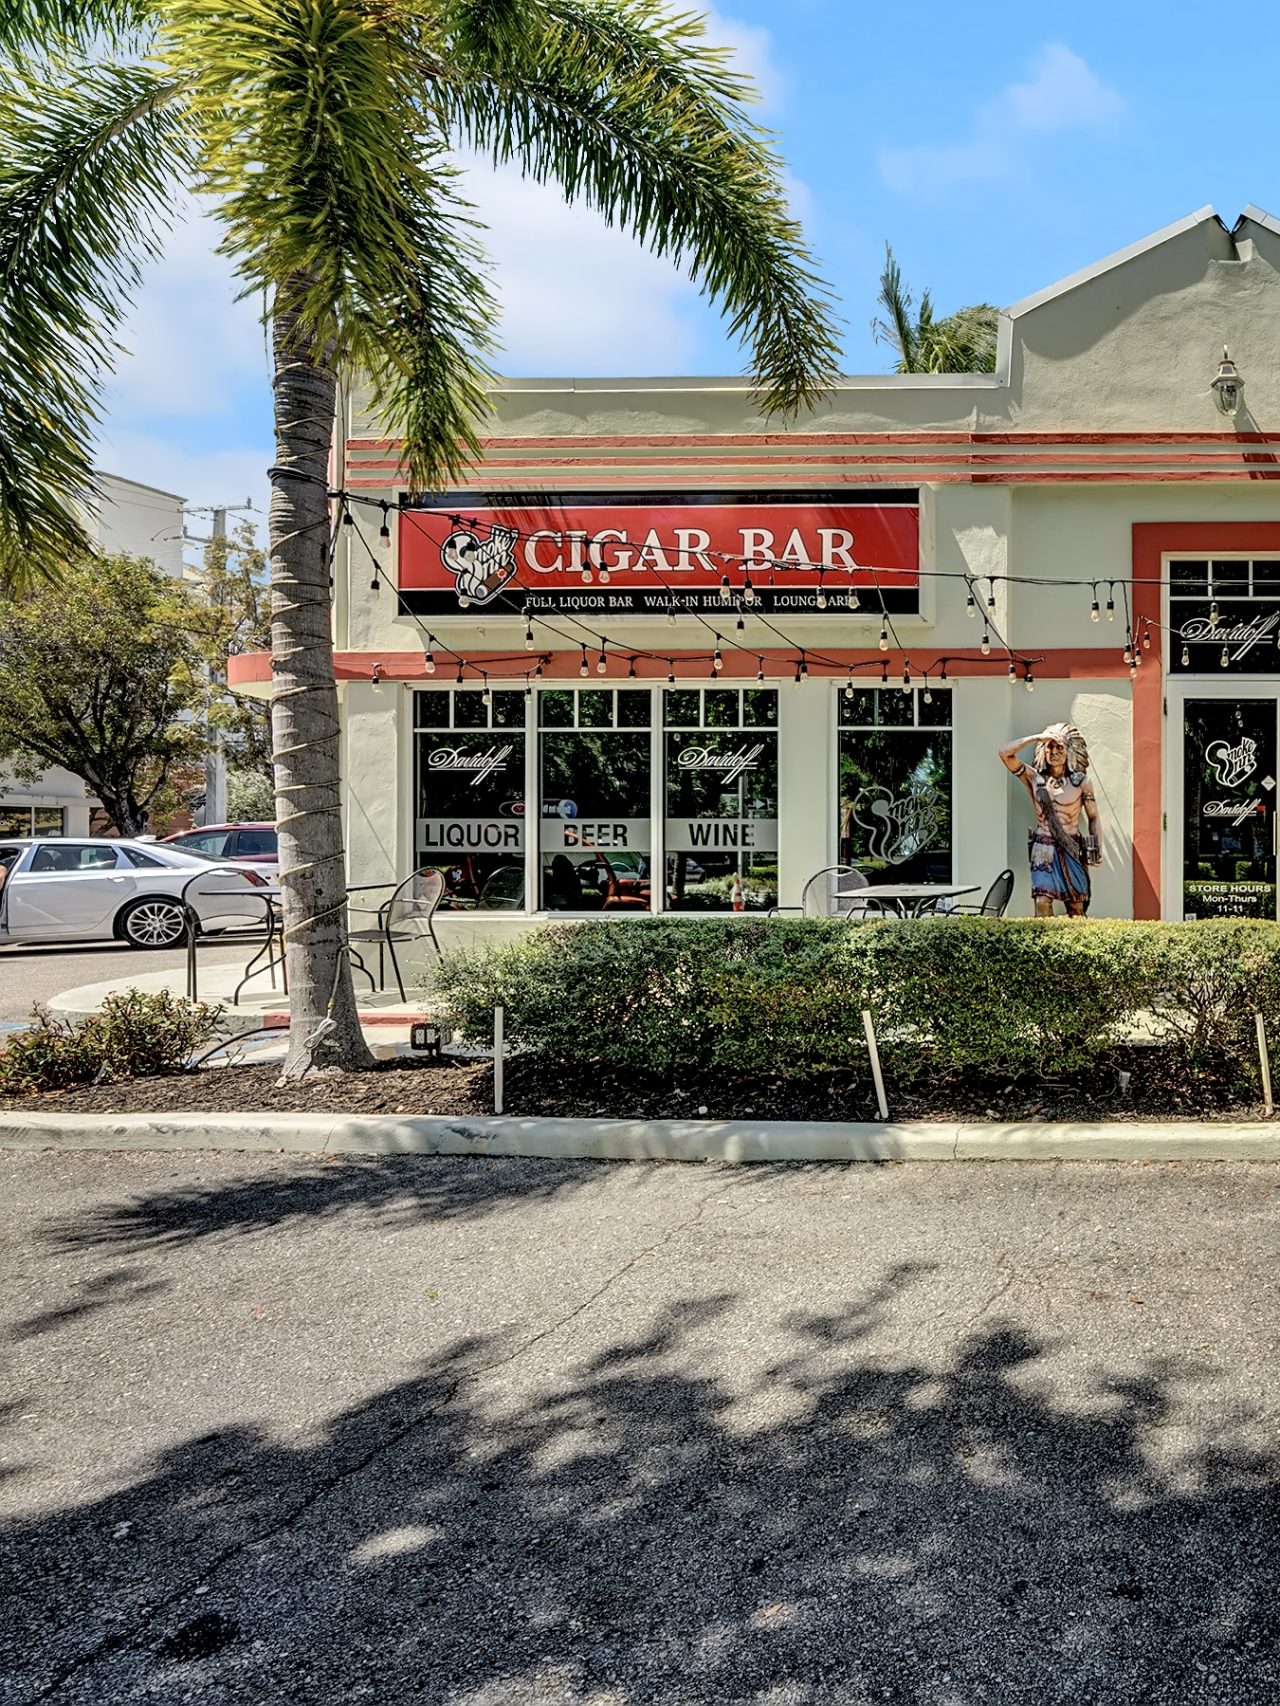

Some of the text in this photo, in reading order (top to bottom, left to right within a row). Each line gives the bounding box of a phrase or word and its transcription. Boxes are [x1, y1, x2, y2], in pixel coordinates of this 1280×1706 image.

[524, 528, 859, 573] CIGAR BAR
[525, 595, 860, 609] FULL LIQUOR BAR WALK-IN HUMIOR LOUNG ARE
[1180, 615, 1280, 661] Davidoff
[428, 745, 513, 785] Davidoff
[678, 744, 764, 784] Davidoff
[1203, 798, 1261, 827] Davidoff
[425, 823, 754, 847] LIQUOR BEER WINE
[1189, 884, 1271, 893] STORE HOURS
[1202, 894, 1257, 903] Mon-Thurs
[1217, 904, 1243, 912] 11-11
